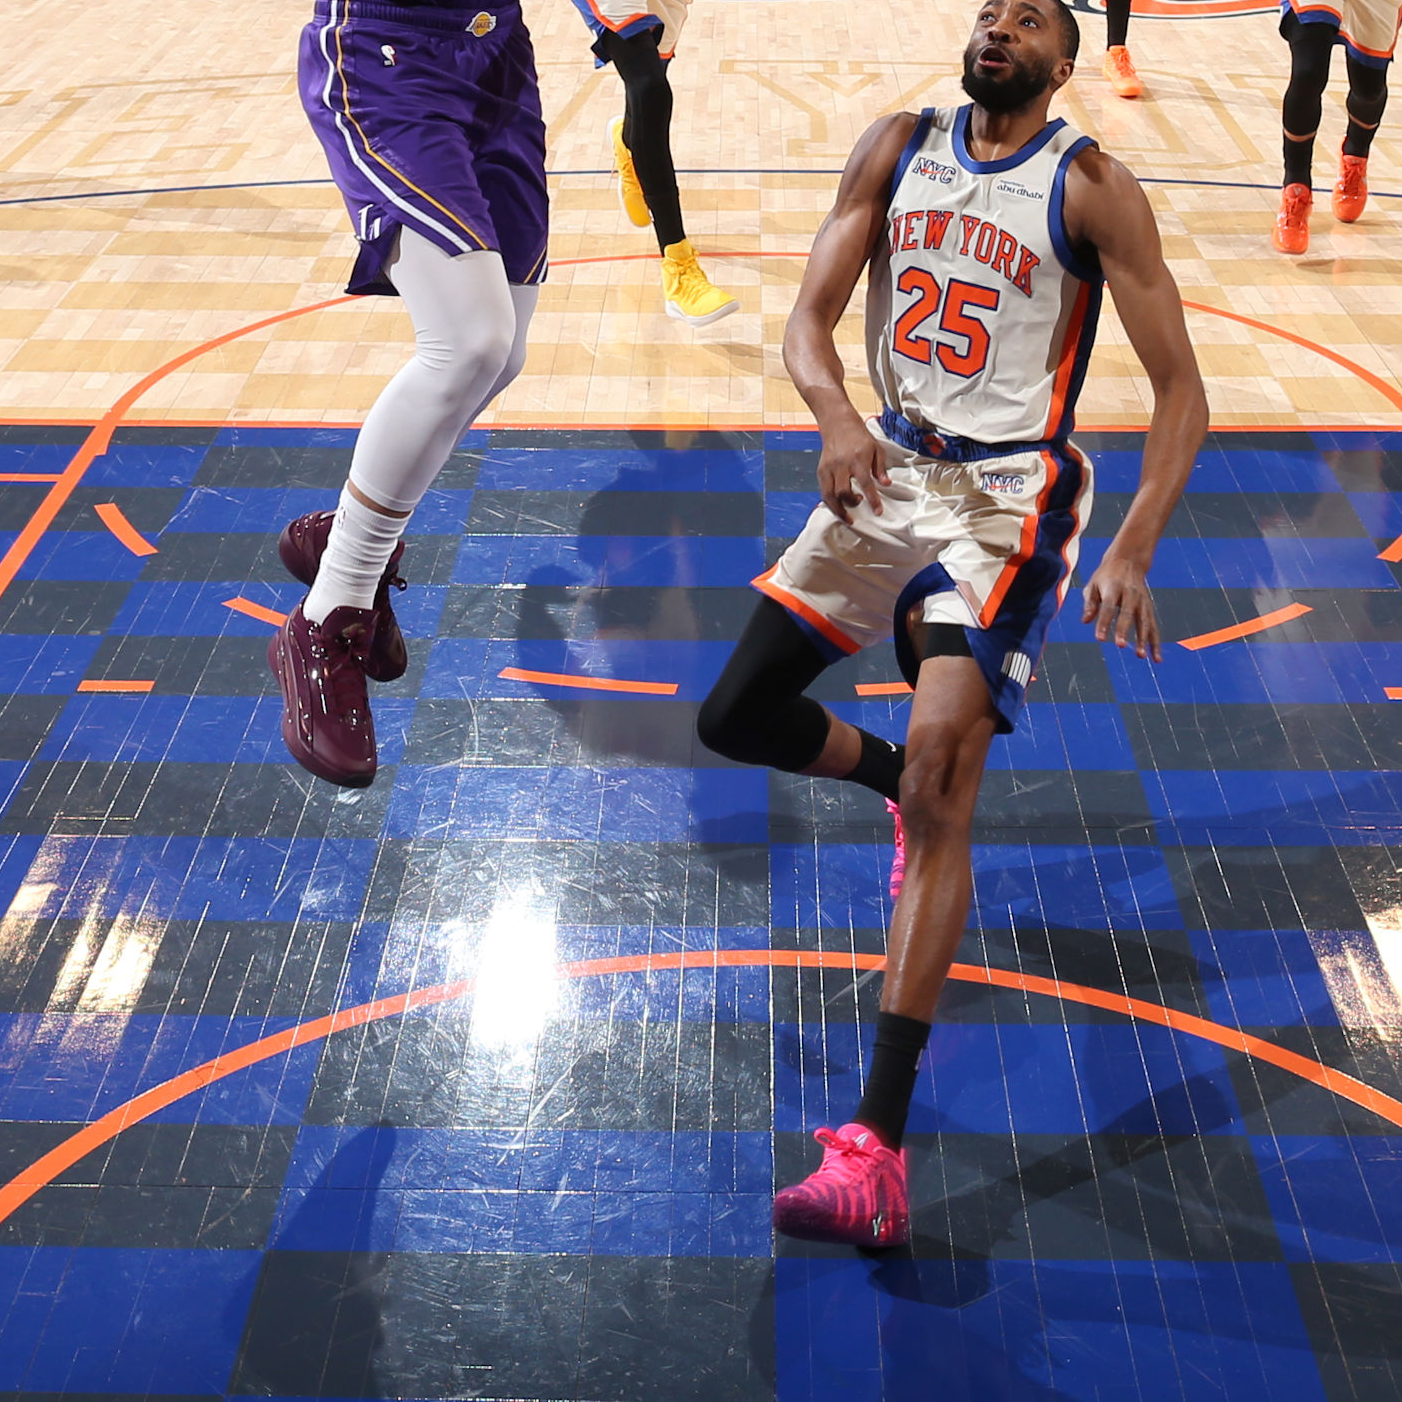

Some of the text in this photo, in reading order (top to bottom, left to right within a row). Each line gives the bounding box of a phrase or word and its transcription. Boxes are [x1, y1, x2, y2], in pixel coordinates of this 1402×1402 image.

[913, 156, 957, 185] NYC
[889, 211, 1042, 299] NEW YORK
[892, 265, 1001, 380] 25
[980, 472, 1025, 494] NYC
